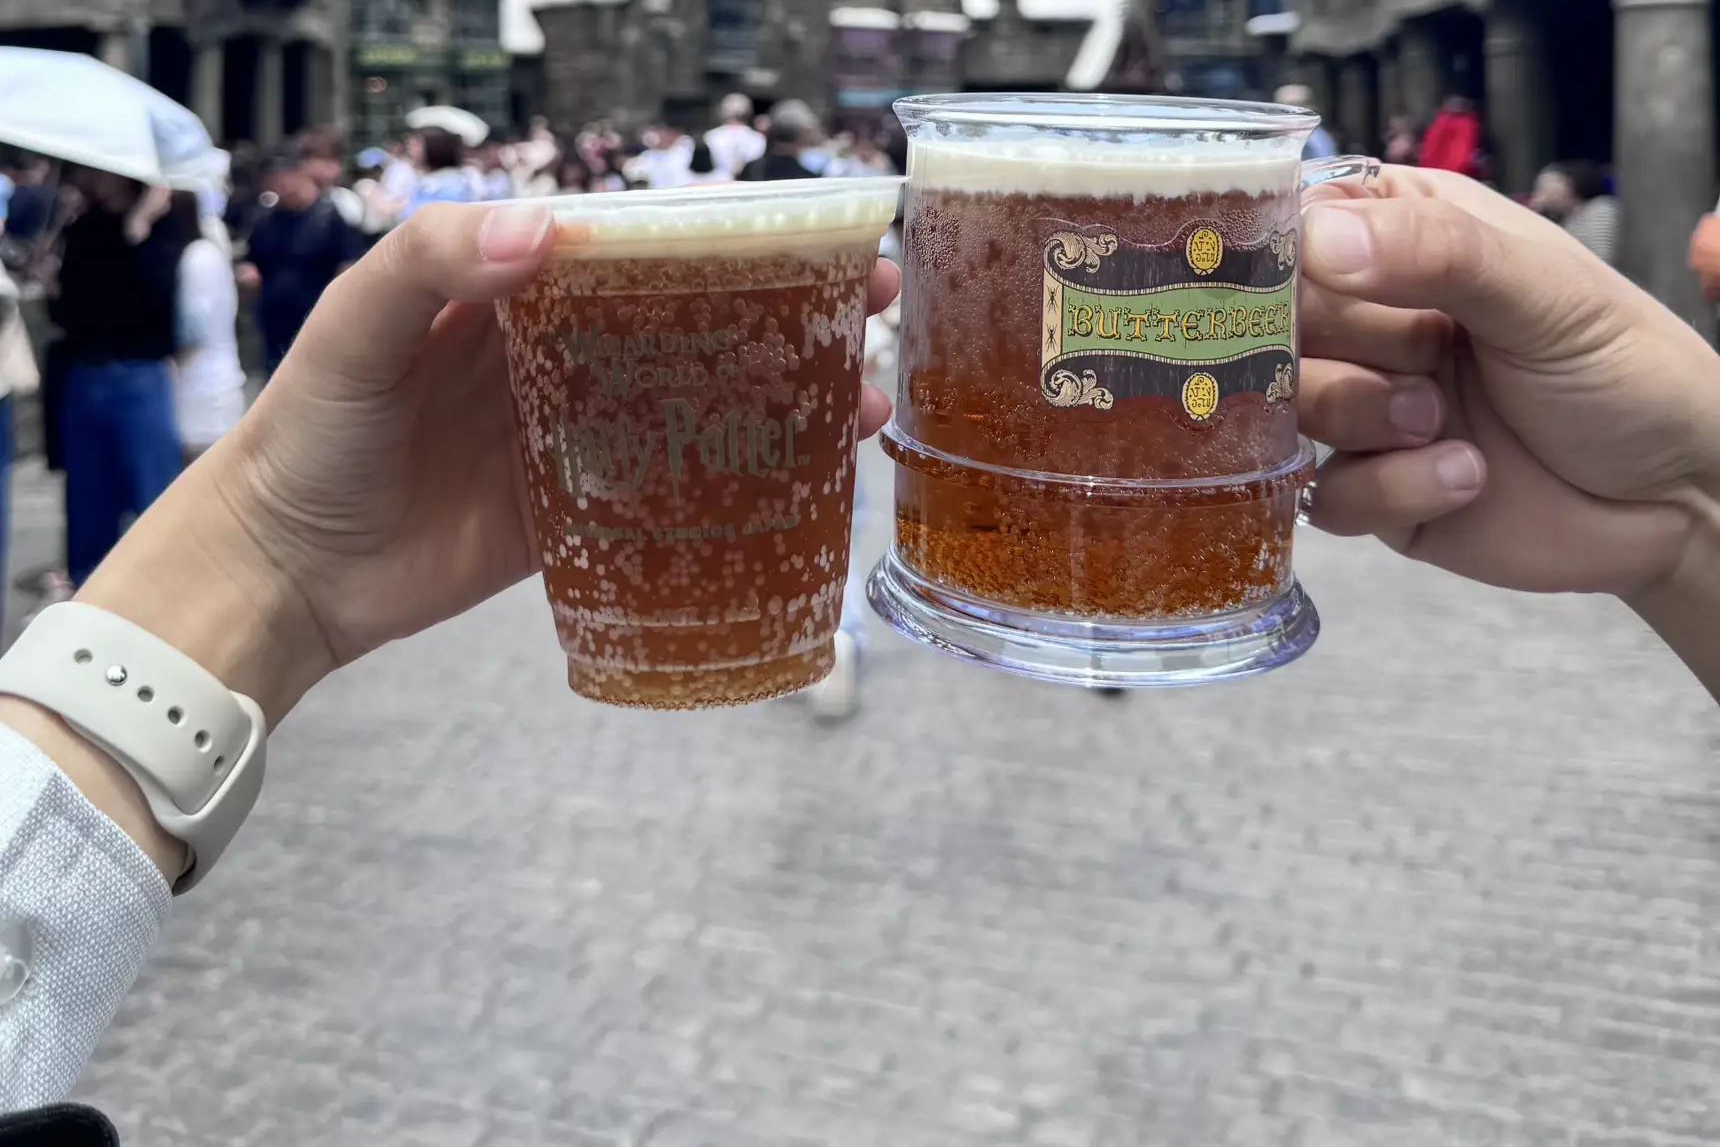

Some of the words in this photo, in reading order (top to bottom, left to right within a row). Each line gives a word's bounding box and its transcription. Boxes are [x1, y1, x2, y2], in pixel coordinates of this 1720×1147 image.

[1068, 302, 1289, 342] BUTTERBEER
[600, 358, 710, 397] WORLD
[658, 398, 804, 506] Potter
